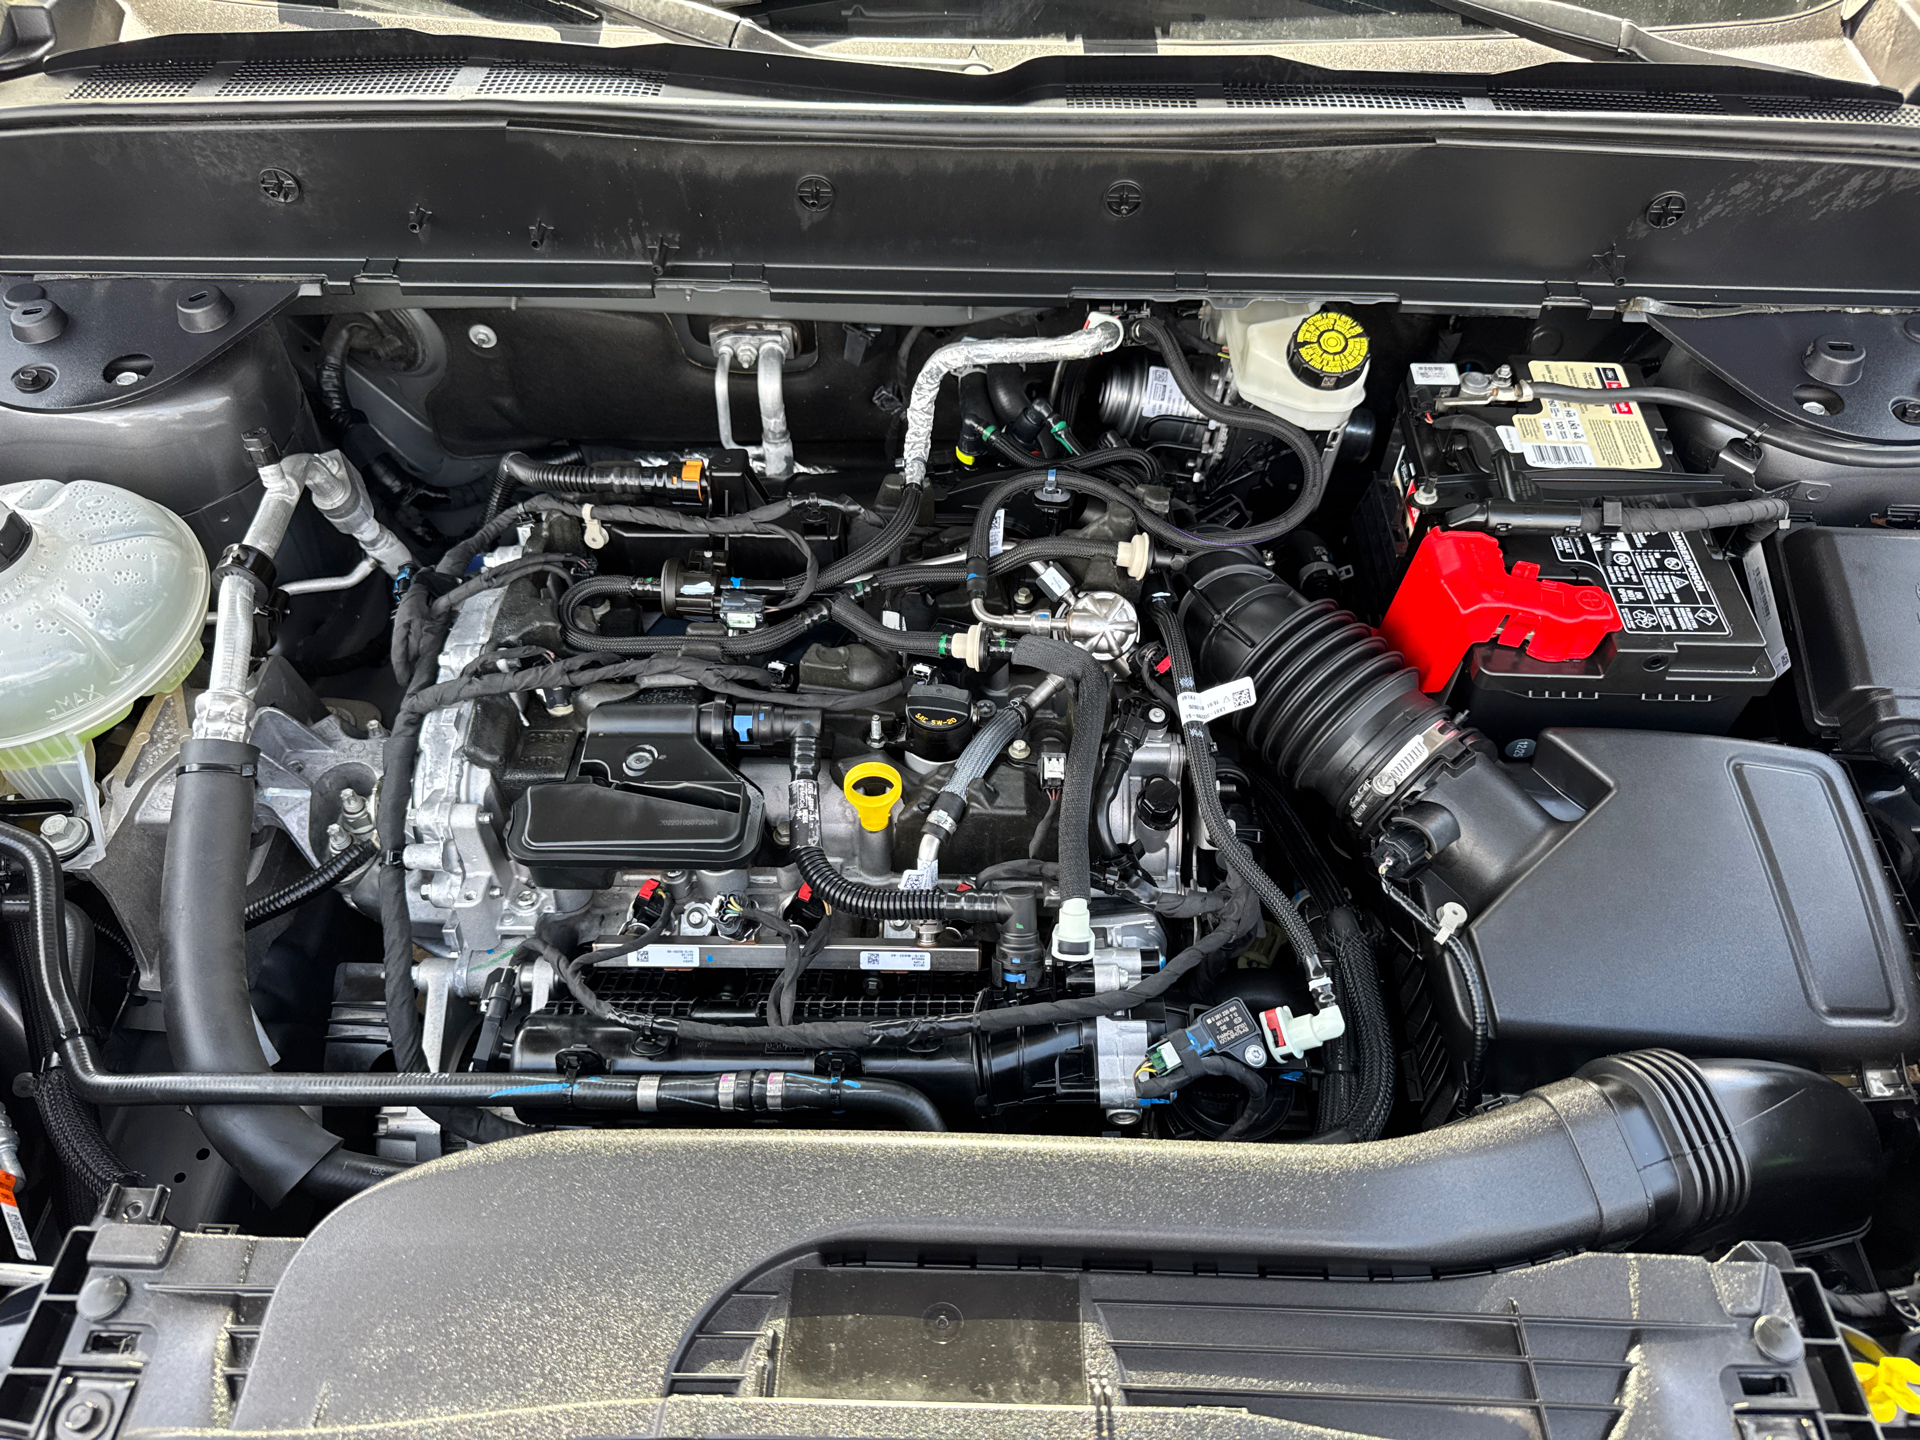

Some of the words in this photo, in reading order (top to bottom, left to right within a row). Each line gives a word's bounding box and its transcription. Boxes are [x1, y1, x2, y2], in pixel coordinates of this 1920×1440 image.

[1669, 531, 1705, 591] DANGER/POISON
[55, 684, 104, 713] MAX
[914, 712, 929, 723] SAE
[931, 717, 957, 726] 5W-20
